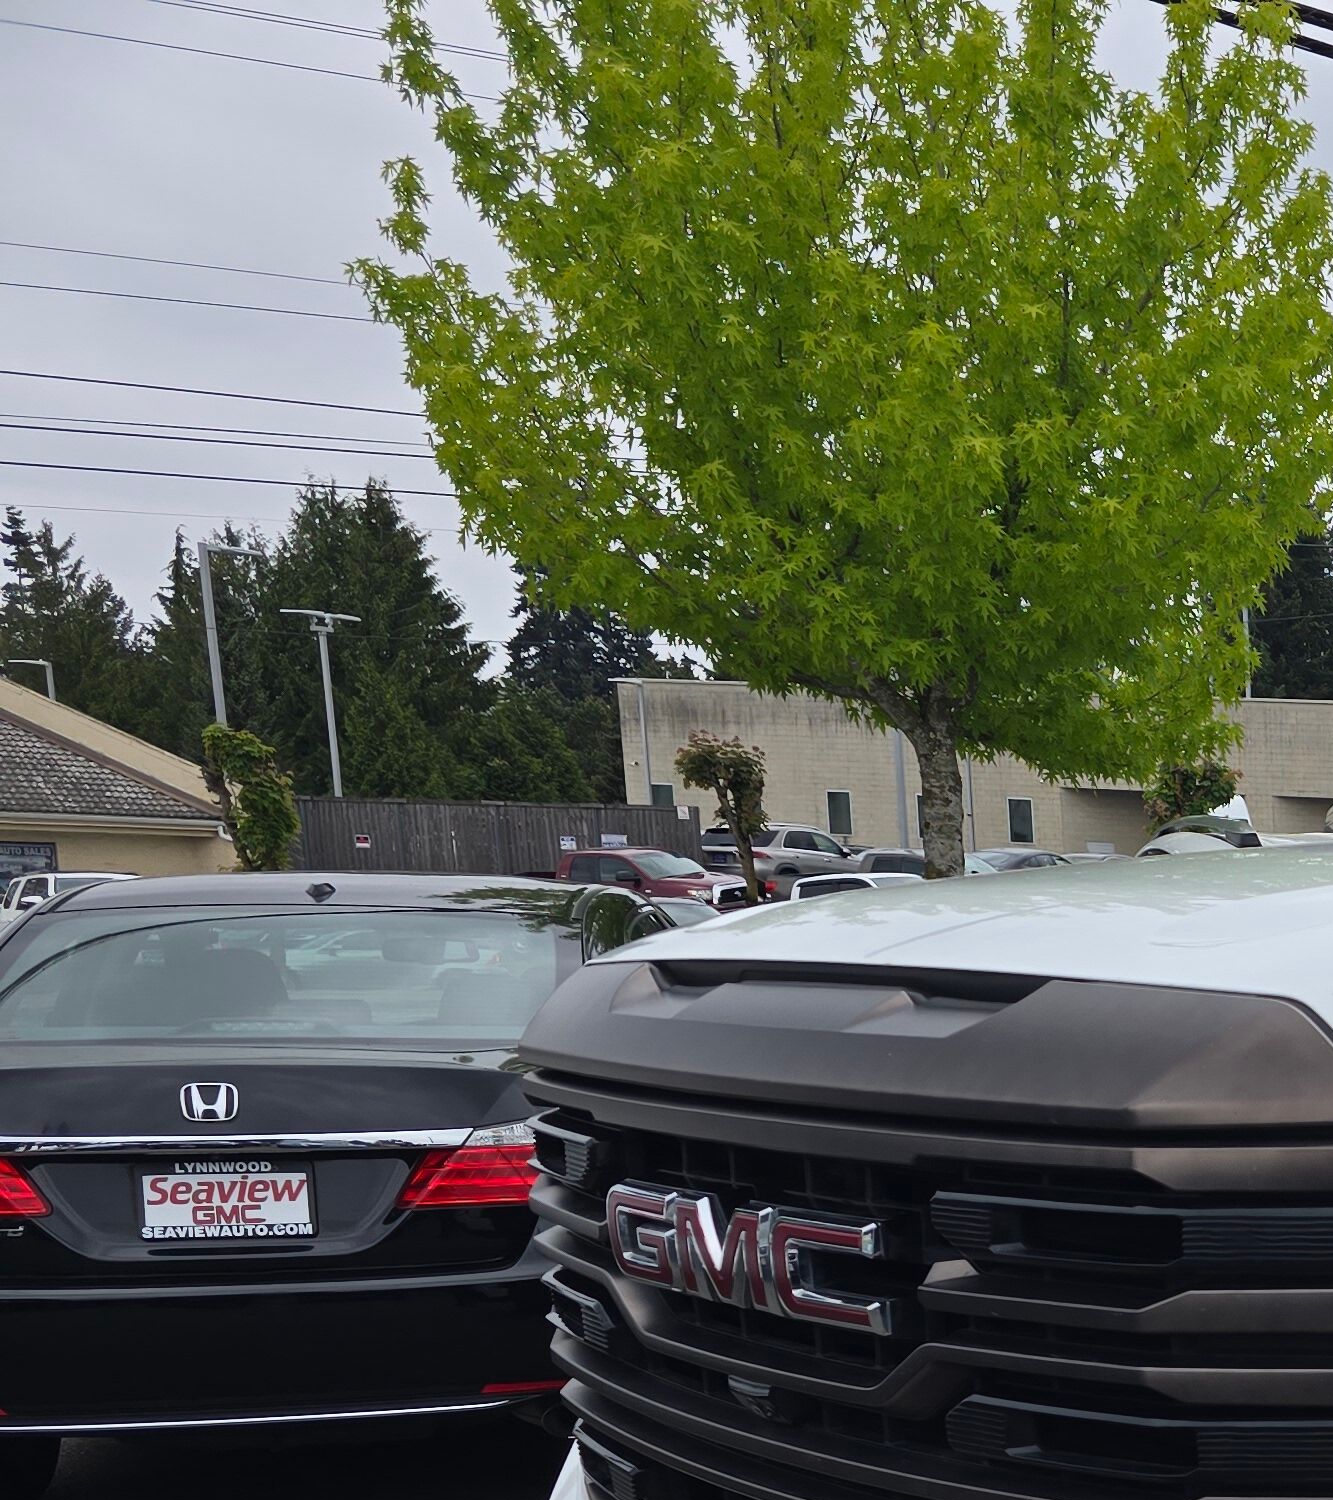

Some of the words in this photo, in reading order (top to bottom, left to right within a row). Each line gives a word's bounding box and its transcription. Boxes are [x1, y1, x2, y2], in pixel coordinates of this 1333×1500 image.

[23, 847, 52, 857] SALES
[174, 1161, 272, 1174] LYNNWOOD
[147, 1175, 308, 1206] Seaview
[191, 1204, 266, 1225] GMC
[141, 1223, 313, 1239] SEAVIEWAUTO.COM
[606, 1182, 893, 1337] GMC
